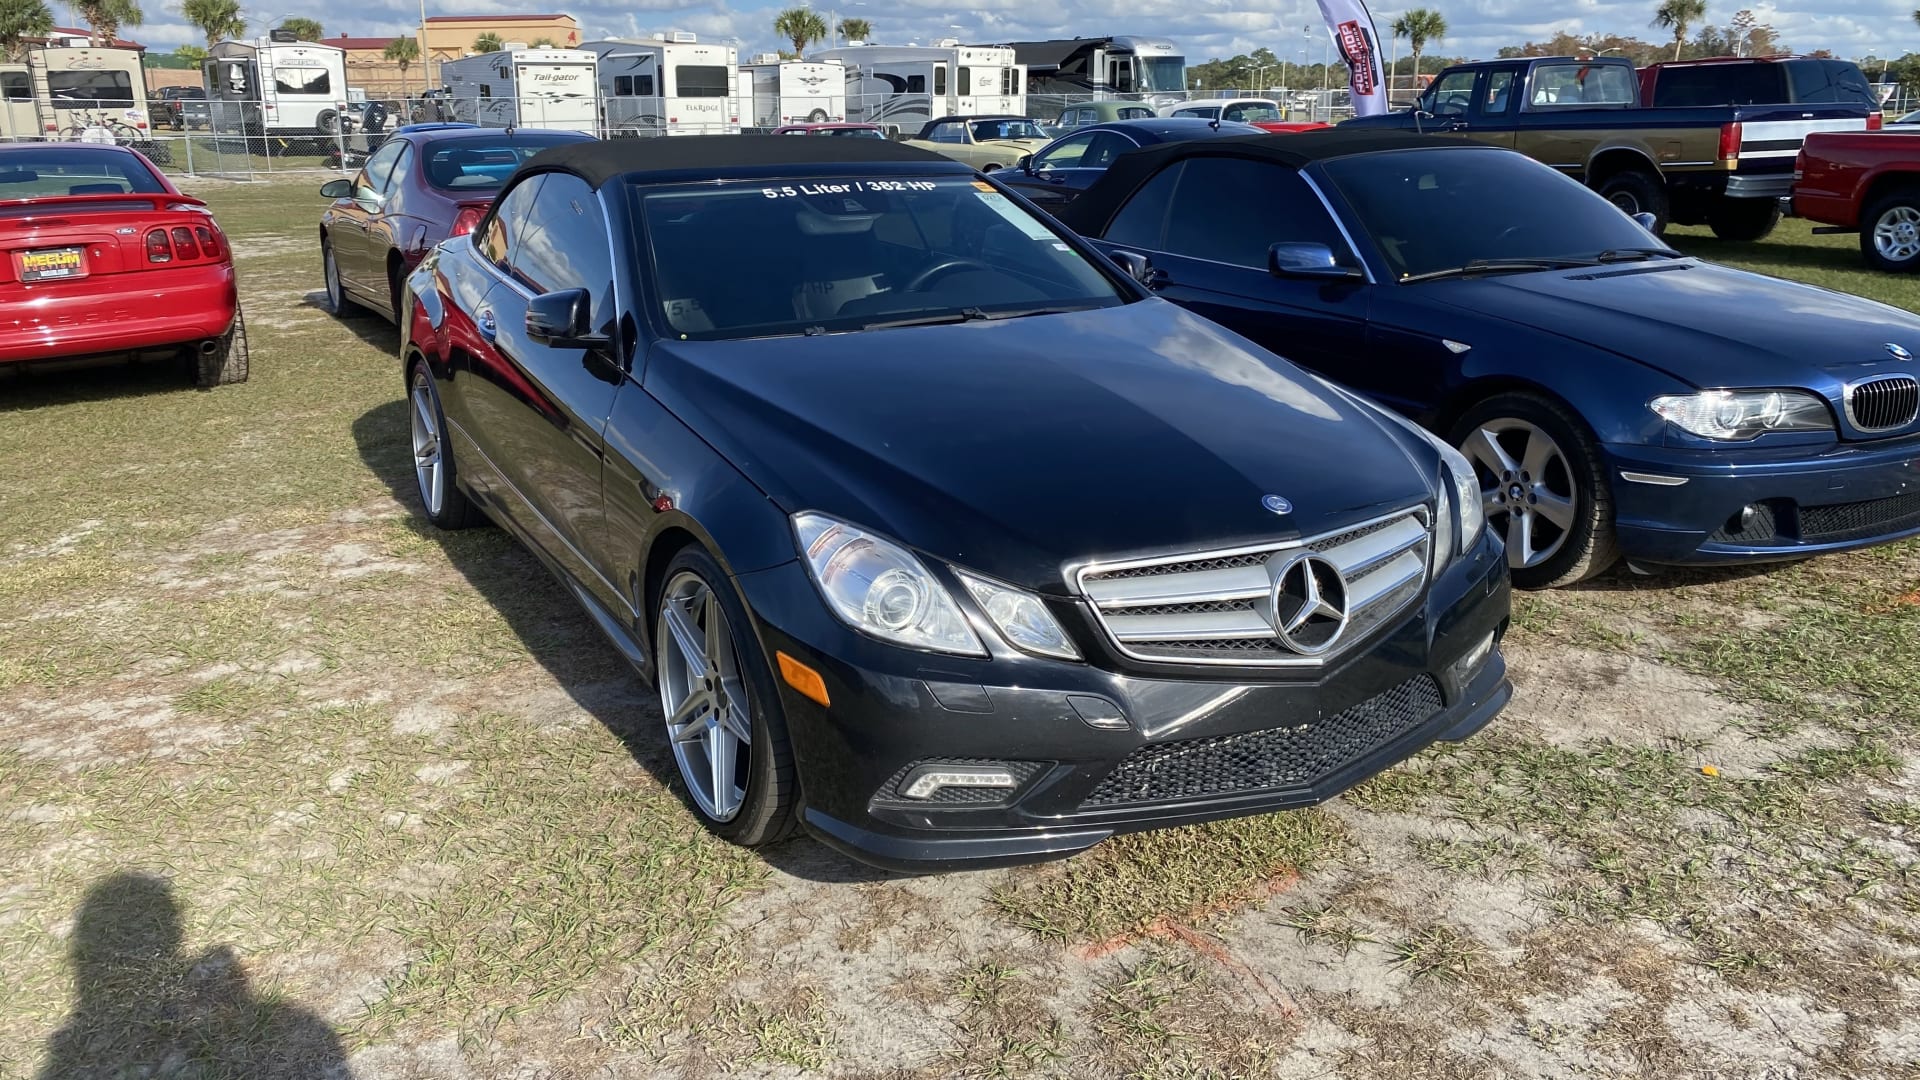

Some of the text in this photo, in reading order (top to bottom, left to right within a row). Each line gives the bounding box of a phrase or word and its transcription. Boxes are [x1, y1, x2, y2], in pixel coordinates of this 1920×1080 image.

[1354, 62, 1366, 94] ROD
[761, 186, 798, 199] 5.5
[800, 184, 851, 195] Liter
[867, 181, 906, 191] 382
[906, 181, 937, 191] HP
[22, 252, 81, 267] MECUM
